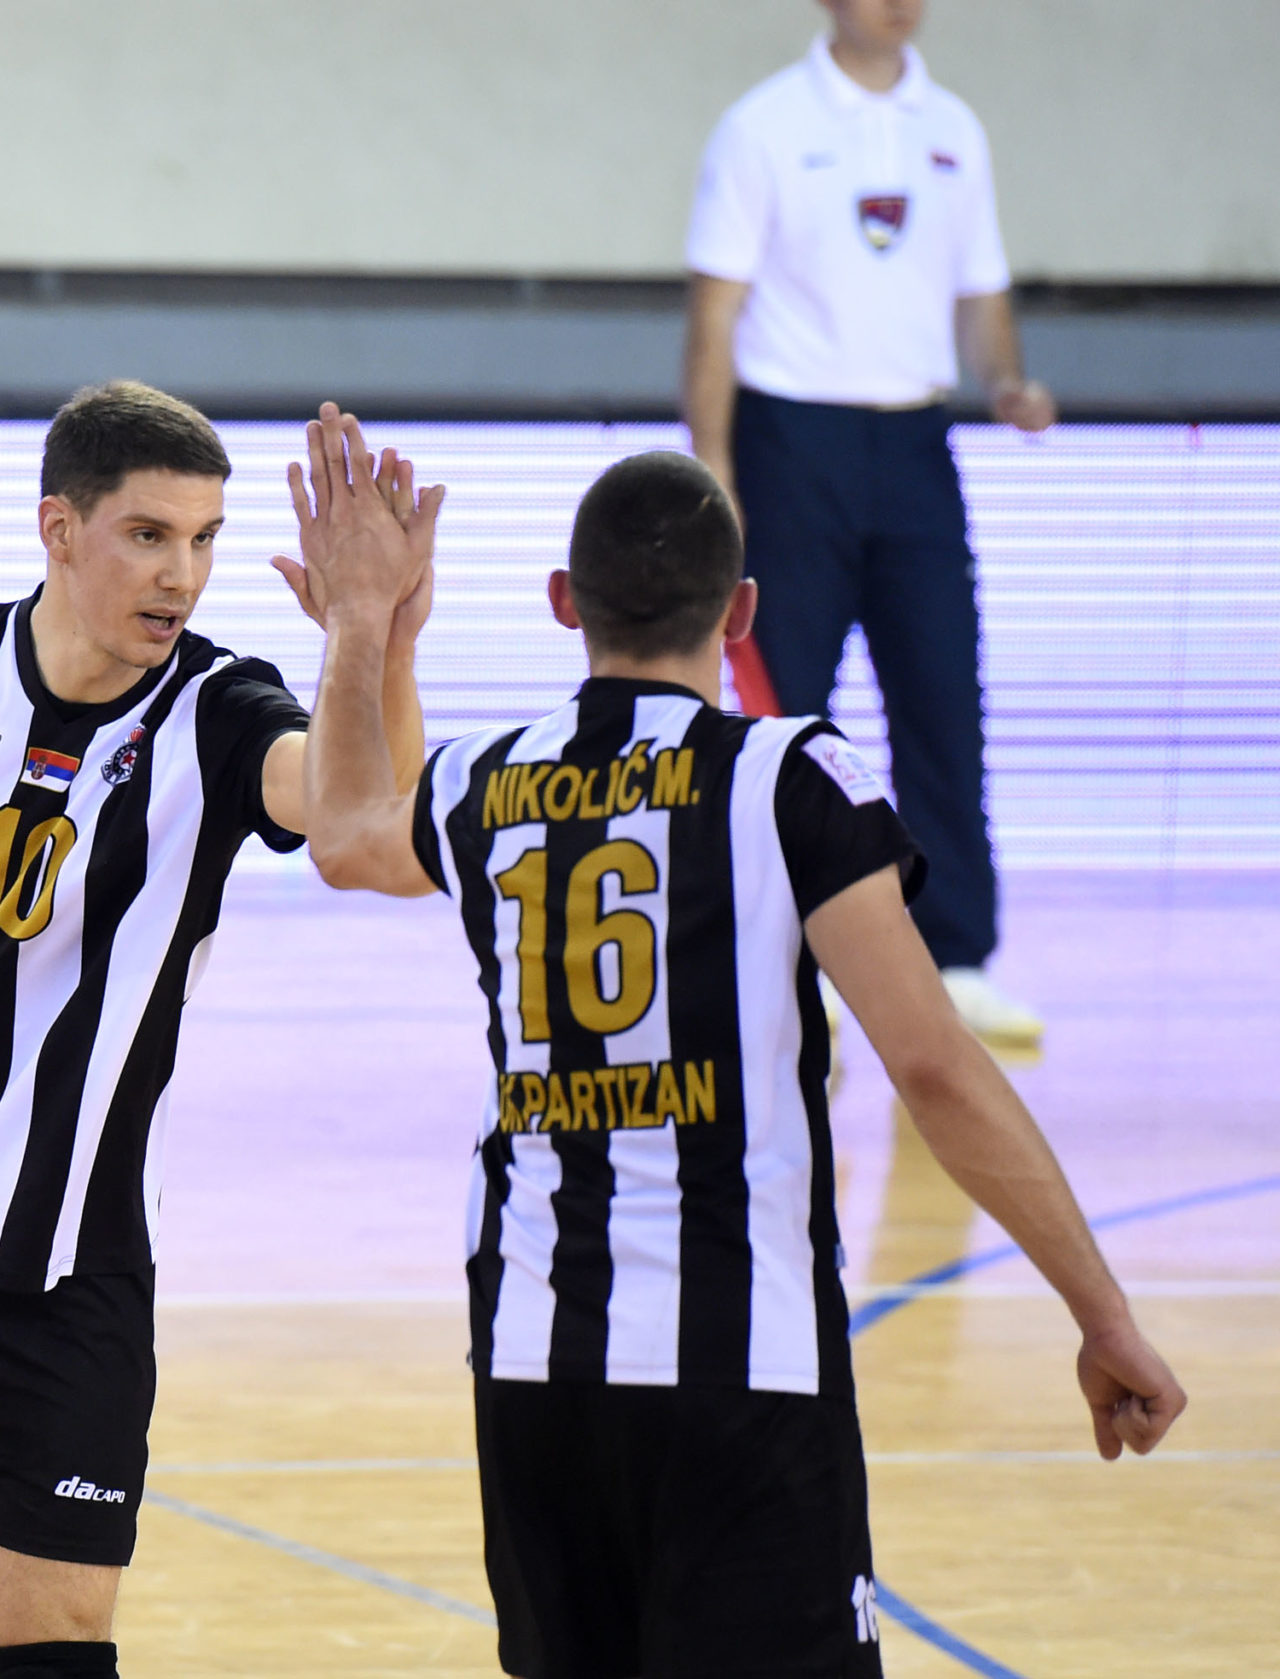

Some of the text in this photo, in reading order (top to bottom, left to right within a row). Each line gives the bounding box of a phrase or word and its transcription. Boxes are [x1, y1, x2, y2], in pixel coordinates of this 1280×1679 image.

[482, 741, 700, 830] NIKOLIĆ M.
[495, 838, 659, 1044] 16
[521, 1059, 717, 1132] PARTIZAN
